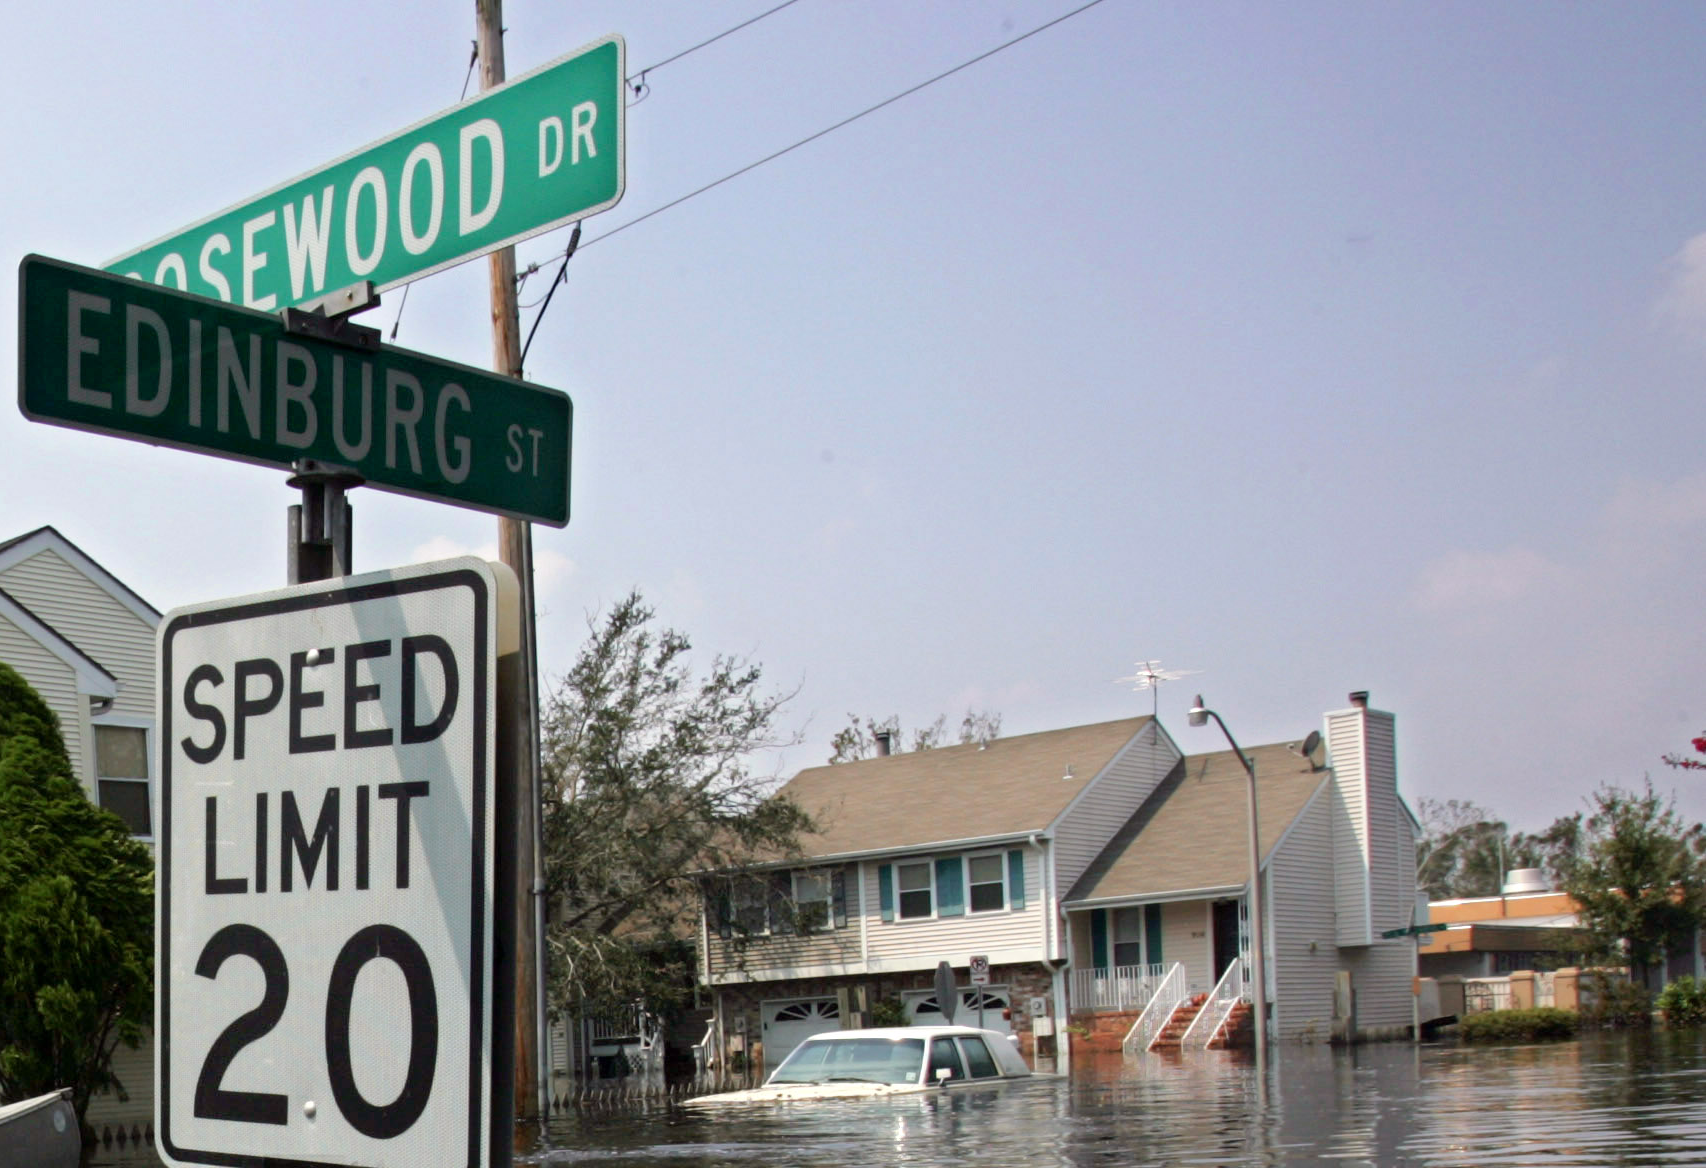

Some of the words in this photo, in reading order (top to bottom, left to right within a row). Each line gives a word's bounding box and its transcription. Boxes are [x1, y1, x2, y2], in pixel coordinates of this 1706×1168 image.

[125, 118, 505, 312] SEWOOD
[538, 100, 598, 179] DR
[67, 289, 471, 484] EDINBURG
[505, 424, 543, 477] ST
[180, 634, 460, 764] SPEED
[205, 781, 430, 895] LIMIT
[194, 923, 439, 1140] 20
